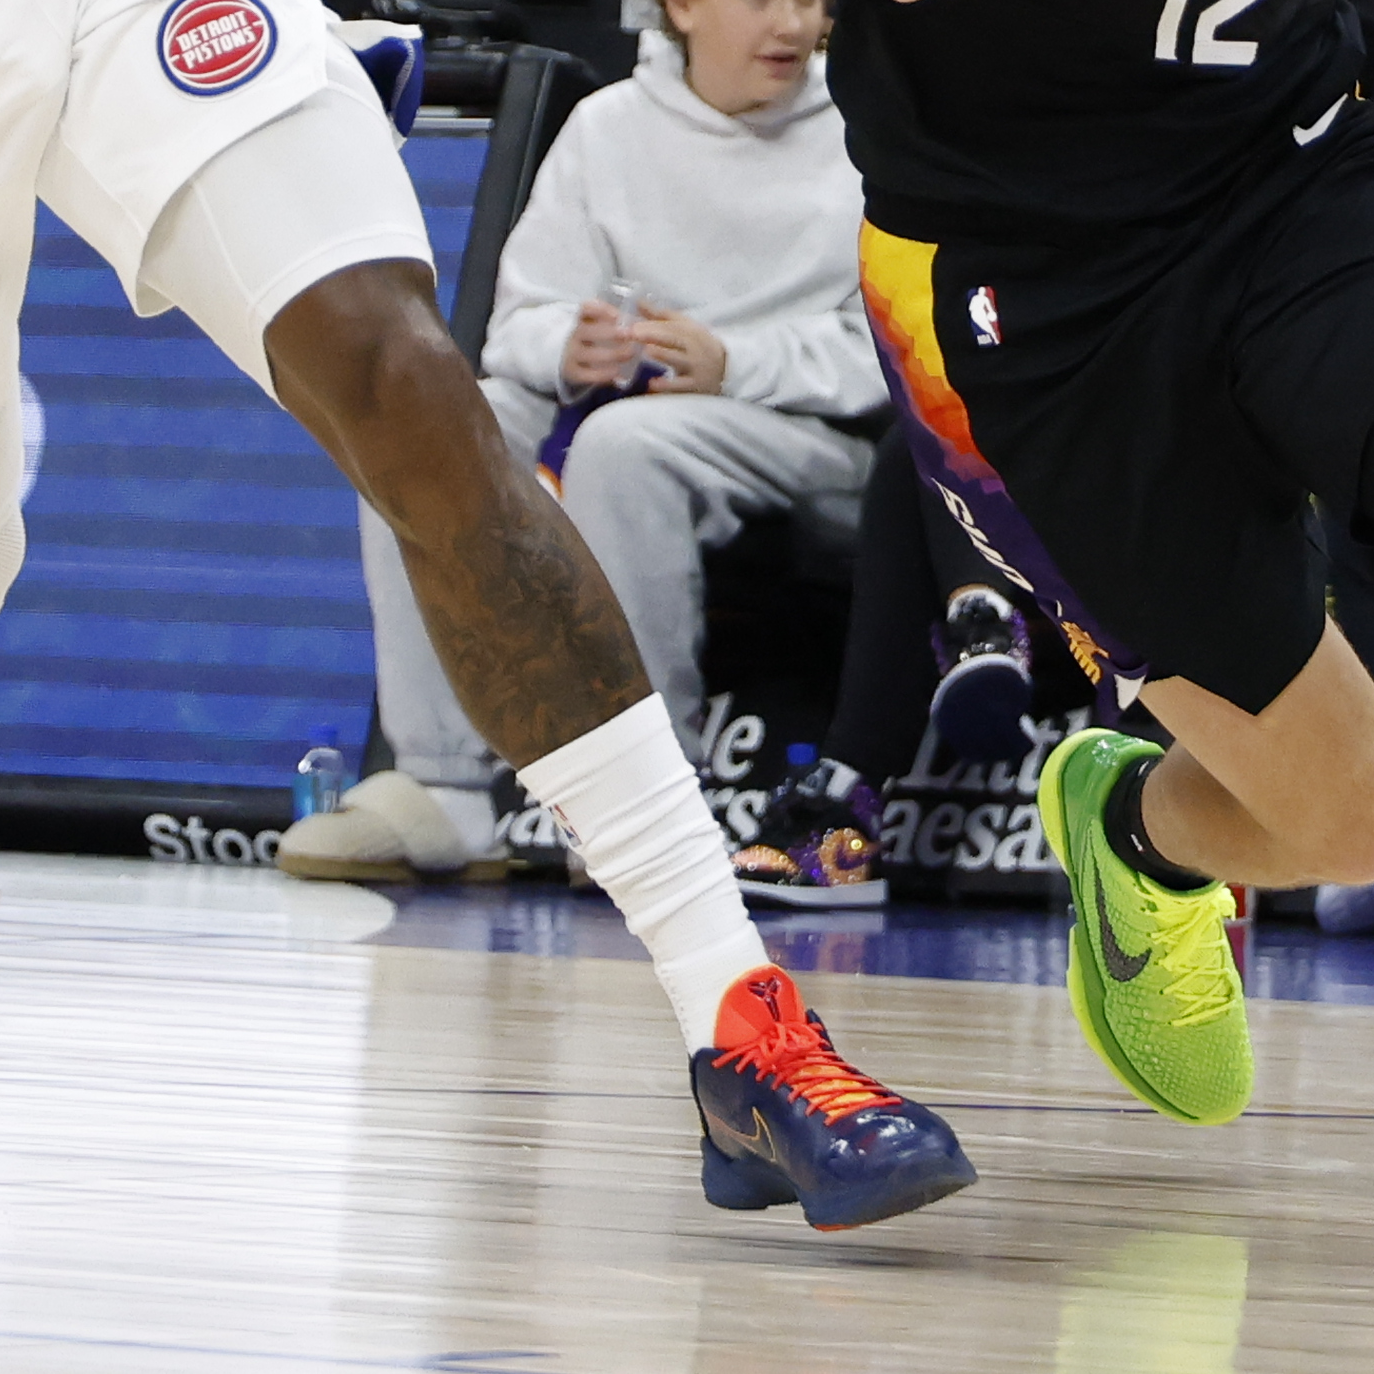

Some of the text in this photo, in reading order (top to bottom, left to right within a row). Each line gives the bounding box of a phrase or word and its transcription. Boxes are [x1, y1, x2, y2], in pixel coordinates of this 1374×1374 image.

[175, 10, 248, 53] DETROIT
[181, 26, 257, 70] PISTONS
[143, 813, 283, 866] Stoc
